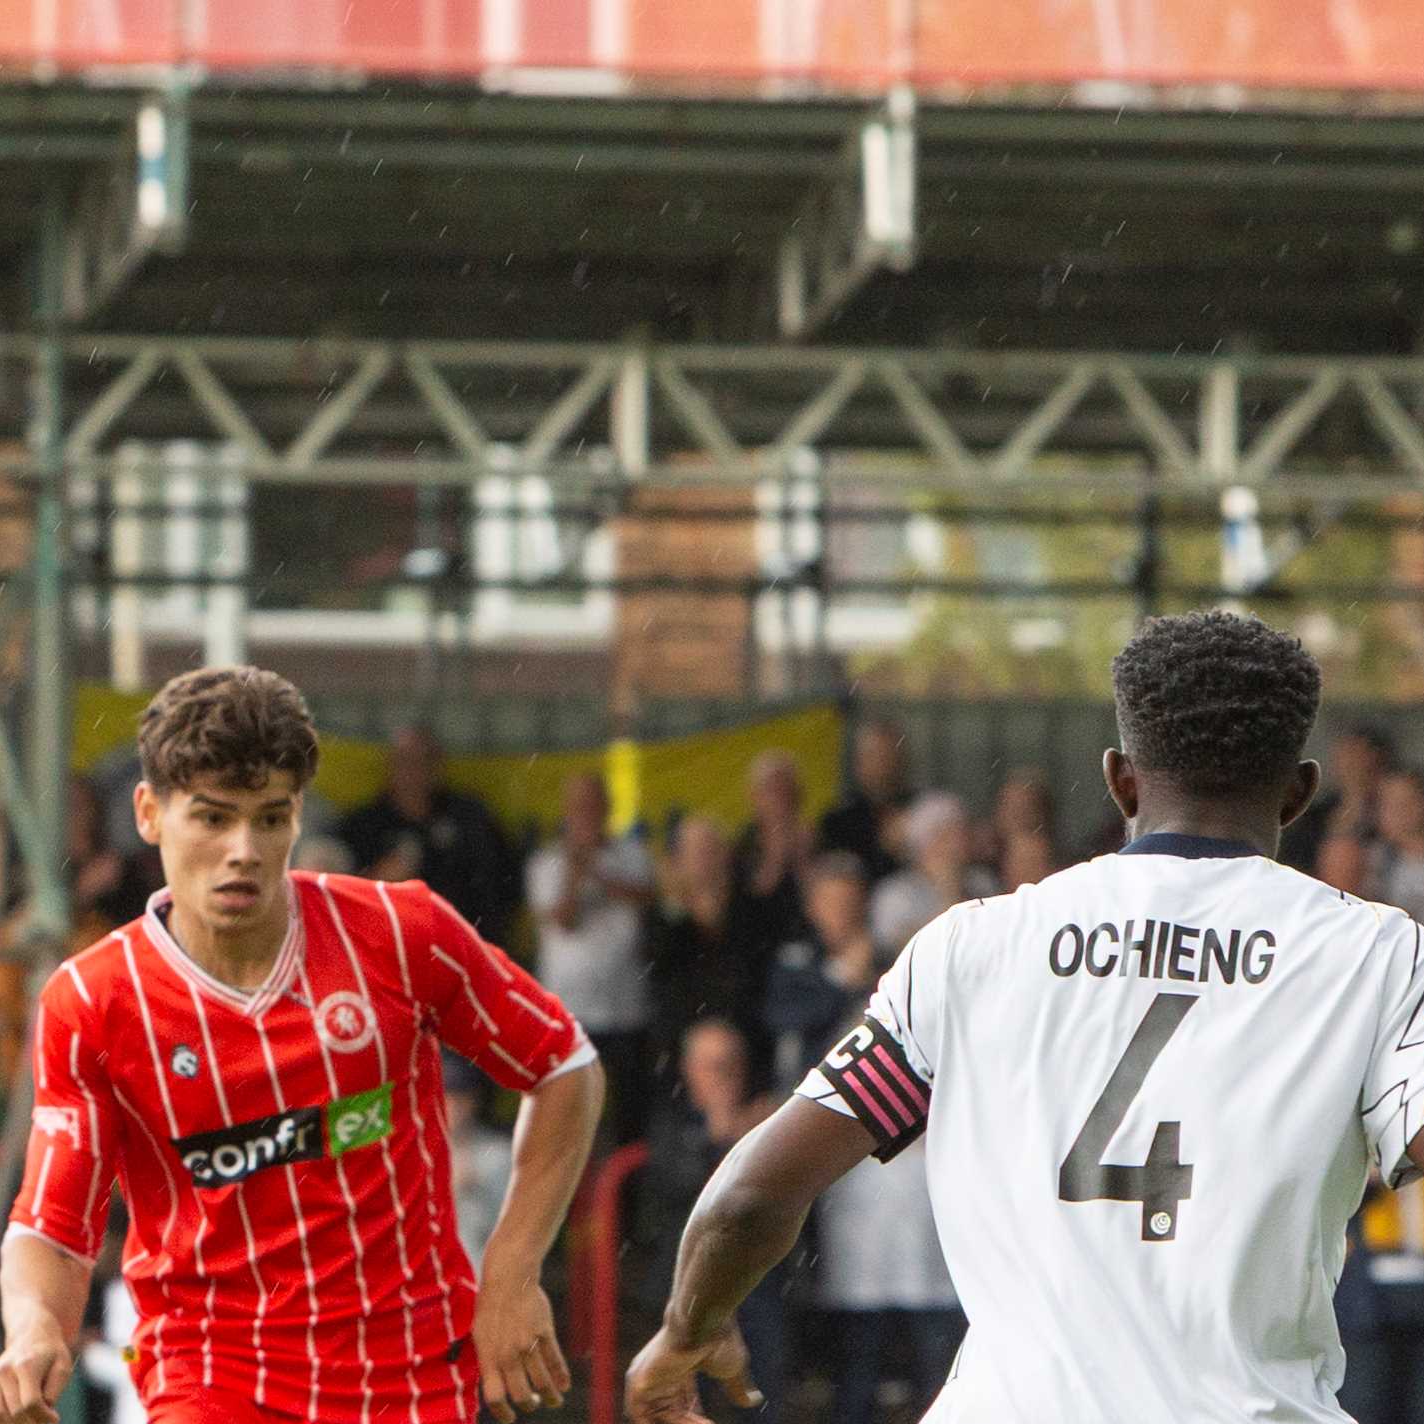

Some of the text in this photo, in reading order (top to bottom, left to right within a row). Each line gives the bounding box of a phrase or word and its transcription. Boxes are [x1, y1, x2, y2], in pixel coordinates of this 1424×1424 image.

[1049, 919, 1275, 984] OCHIENG
[825, 1025, 874, 1069] C
[1058, 992, 1200, 1241] 4
